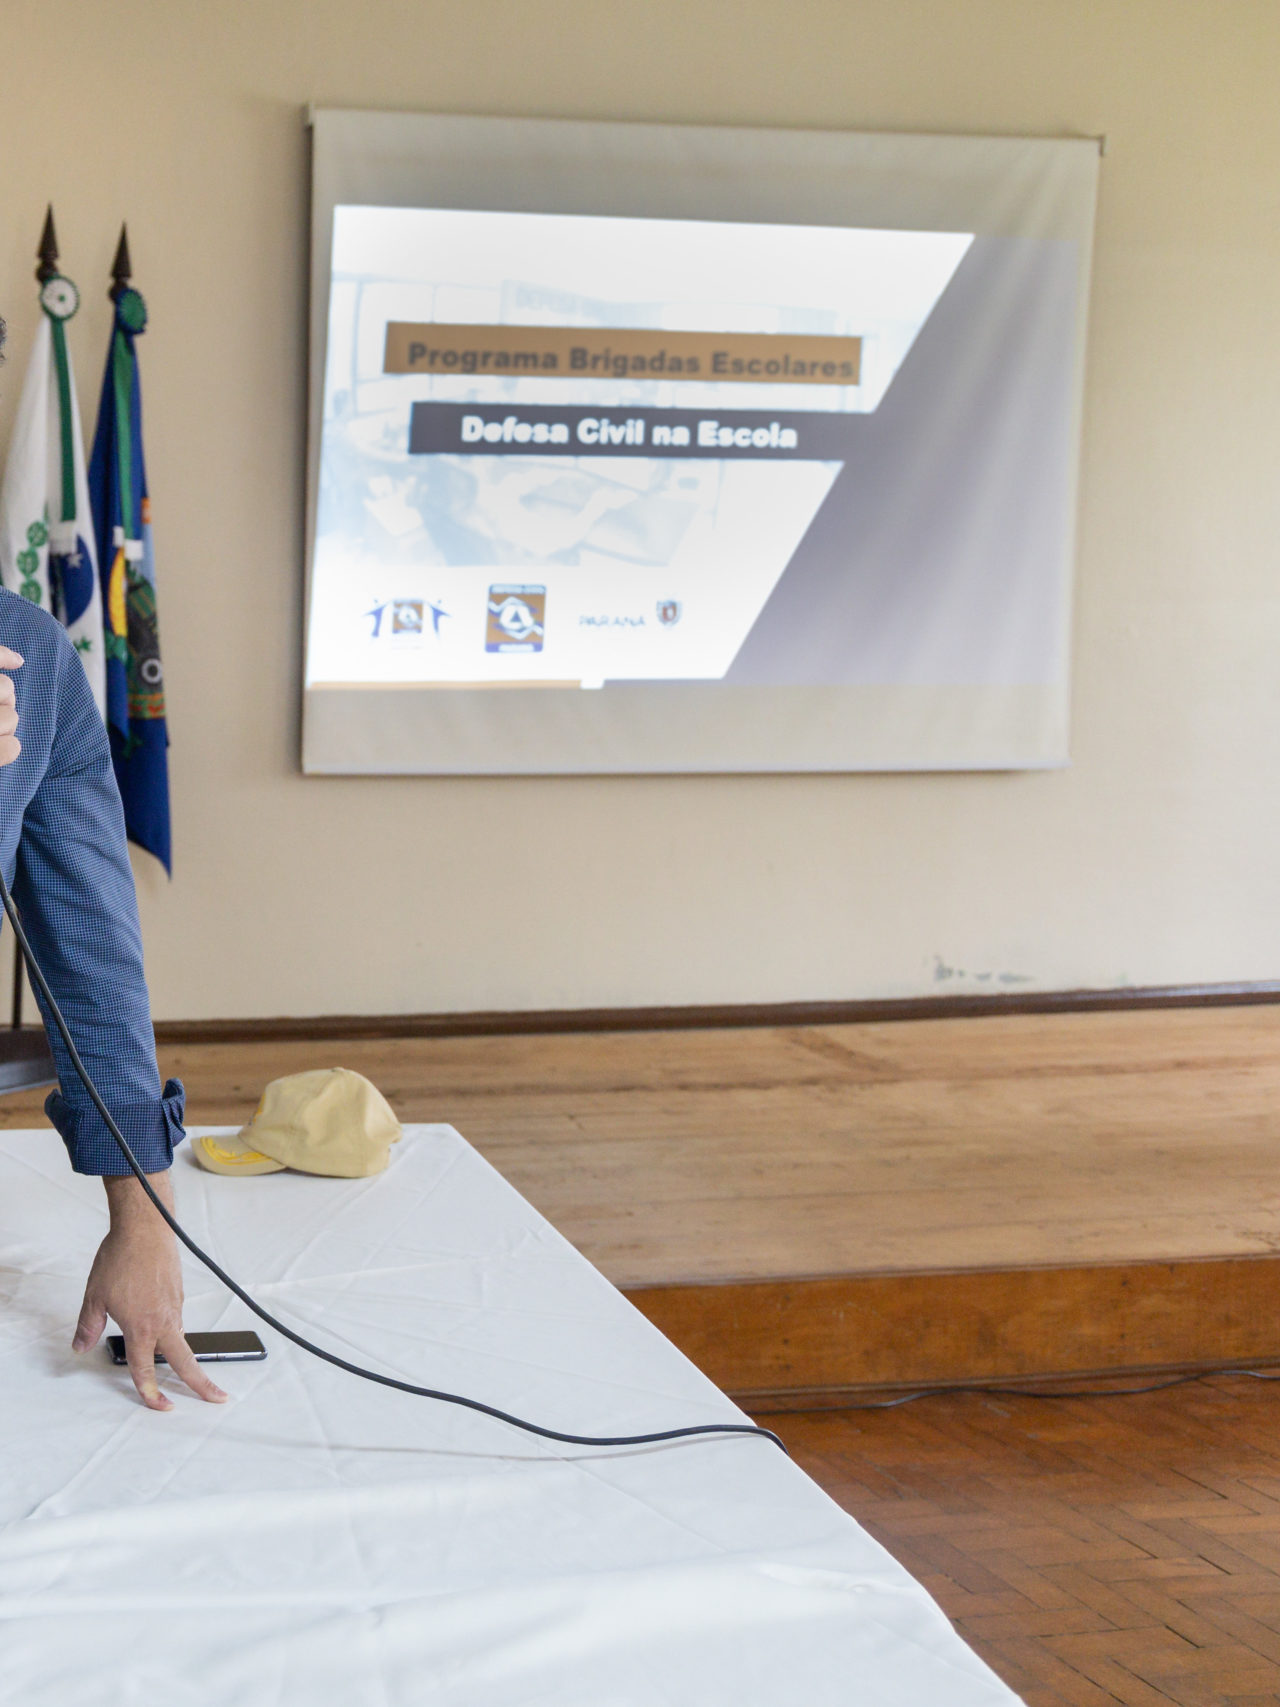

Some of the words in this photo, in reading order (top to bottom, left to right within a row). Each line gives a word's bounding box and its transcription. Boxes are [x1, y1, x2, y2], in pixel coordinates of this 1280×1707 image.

[408, 341, 558, 373] Programa
[569, 347, 700, 377] Brigadas
[711, 352, 854, 378] Escolares
[461, 415, 569, 443] Defesa
[577, 418, 645, 445] Civil
[652, 426, 690, 446] na
[698, 421, 798, 448] Escola
